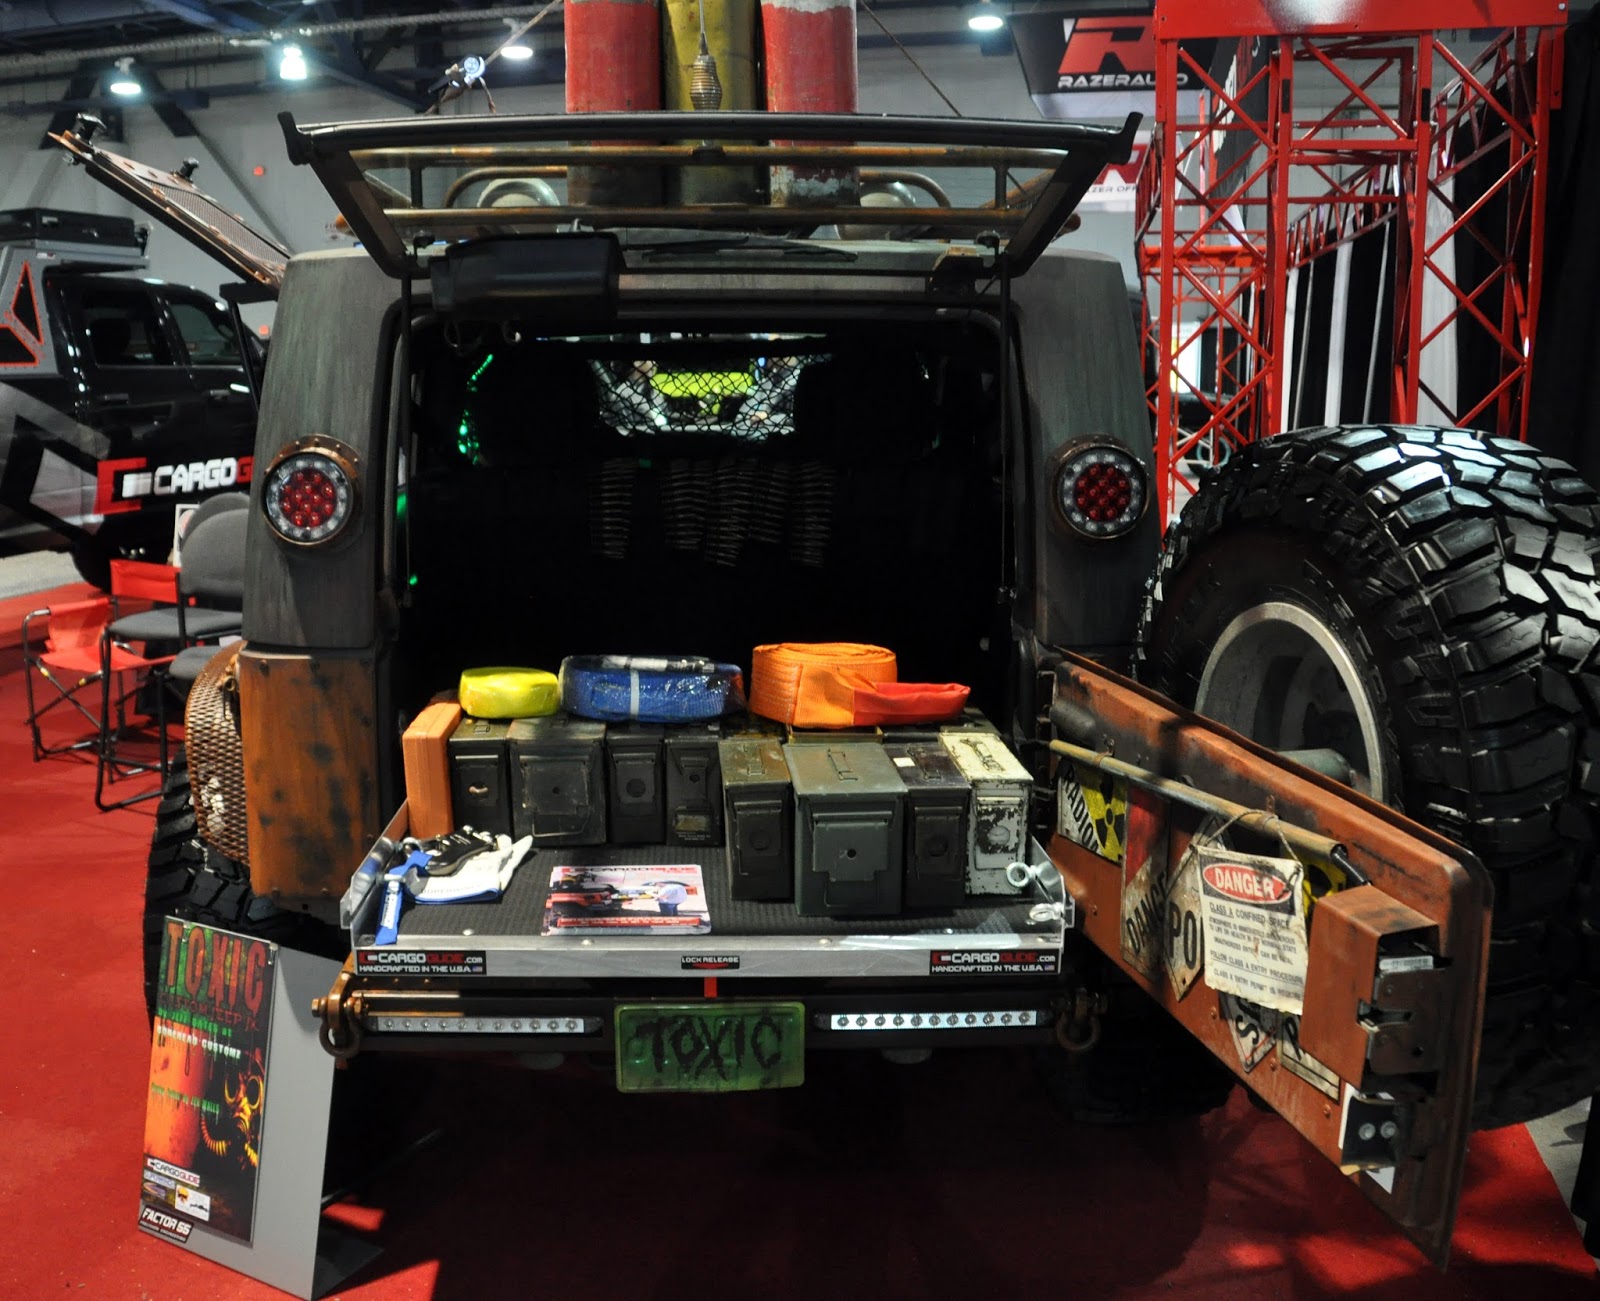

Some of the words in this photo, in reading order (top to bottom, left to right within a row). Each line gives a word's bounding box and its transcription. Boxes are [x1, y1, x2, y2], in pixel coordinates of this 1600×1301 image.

[1214, 867, 1276, 900] DANGER
[1209, 902, 1227, 917] CLASS
[1227, 909, 1233, 917] A
[1235, 910, 1266, 925] CONFINED
[166, 921, 266, 1017] TOXIC
[359, 965, 421, 973] HANDCRAFTED
[421, 965, 430, 973] IN
[431, 965, 449, 973] THE
[681, 956, 702, 964] LOCK
[702, 956, 739, 964] RELEASE
[932, 965, 993, 973] HANDCRAFTED
[993, 964, 1003, 972] IN
[1003, 964, 1020, 972] THE
[1209, 949, 1227, 961] FOLLOW
[1228, 956, 1244, 968] CLASS
[1251, 963, 1267, 974] ENTRY
[211, 1007, 242, 1025] JEEP
[201, 1038, 242, 1060] CUSTOMZ
[141, 1207, 179, 1231] FACTOR
[176, 1220, 193, 1236] 55
